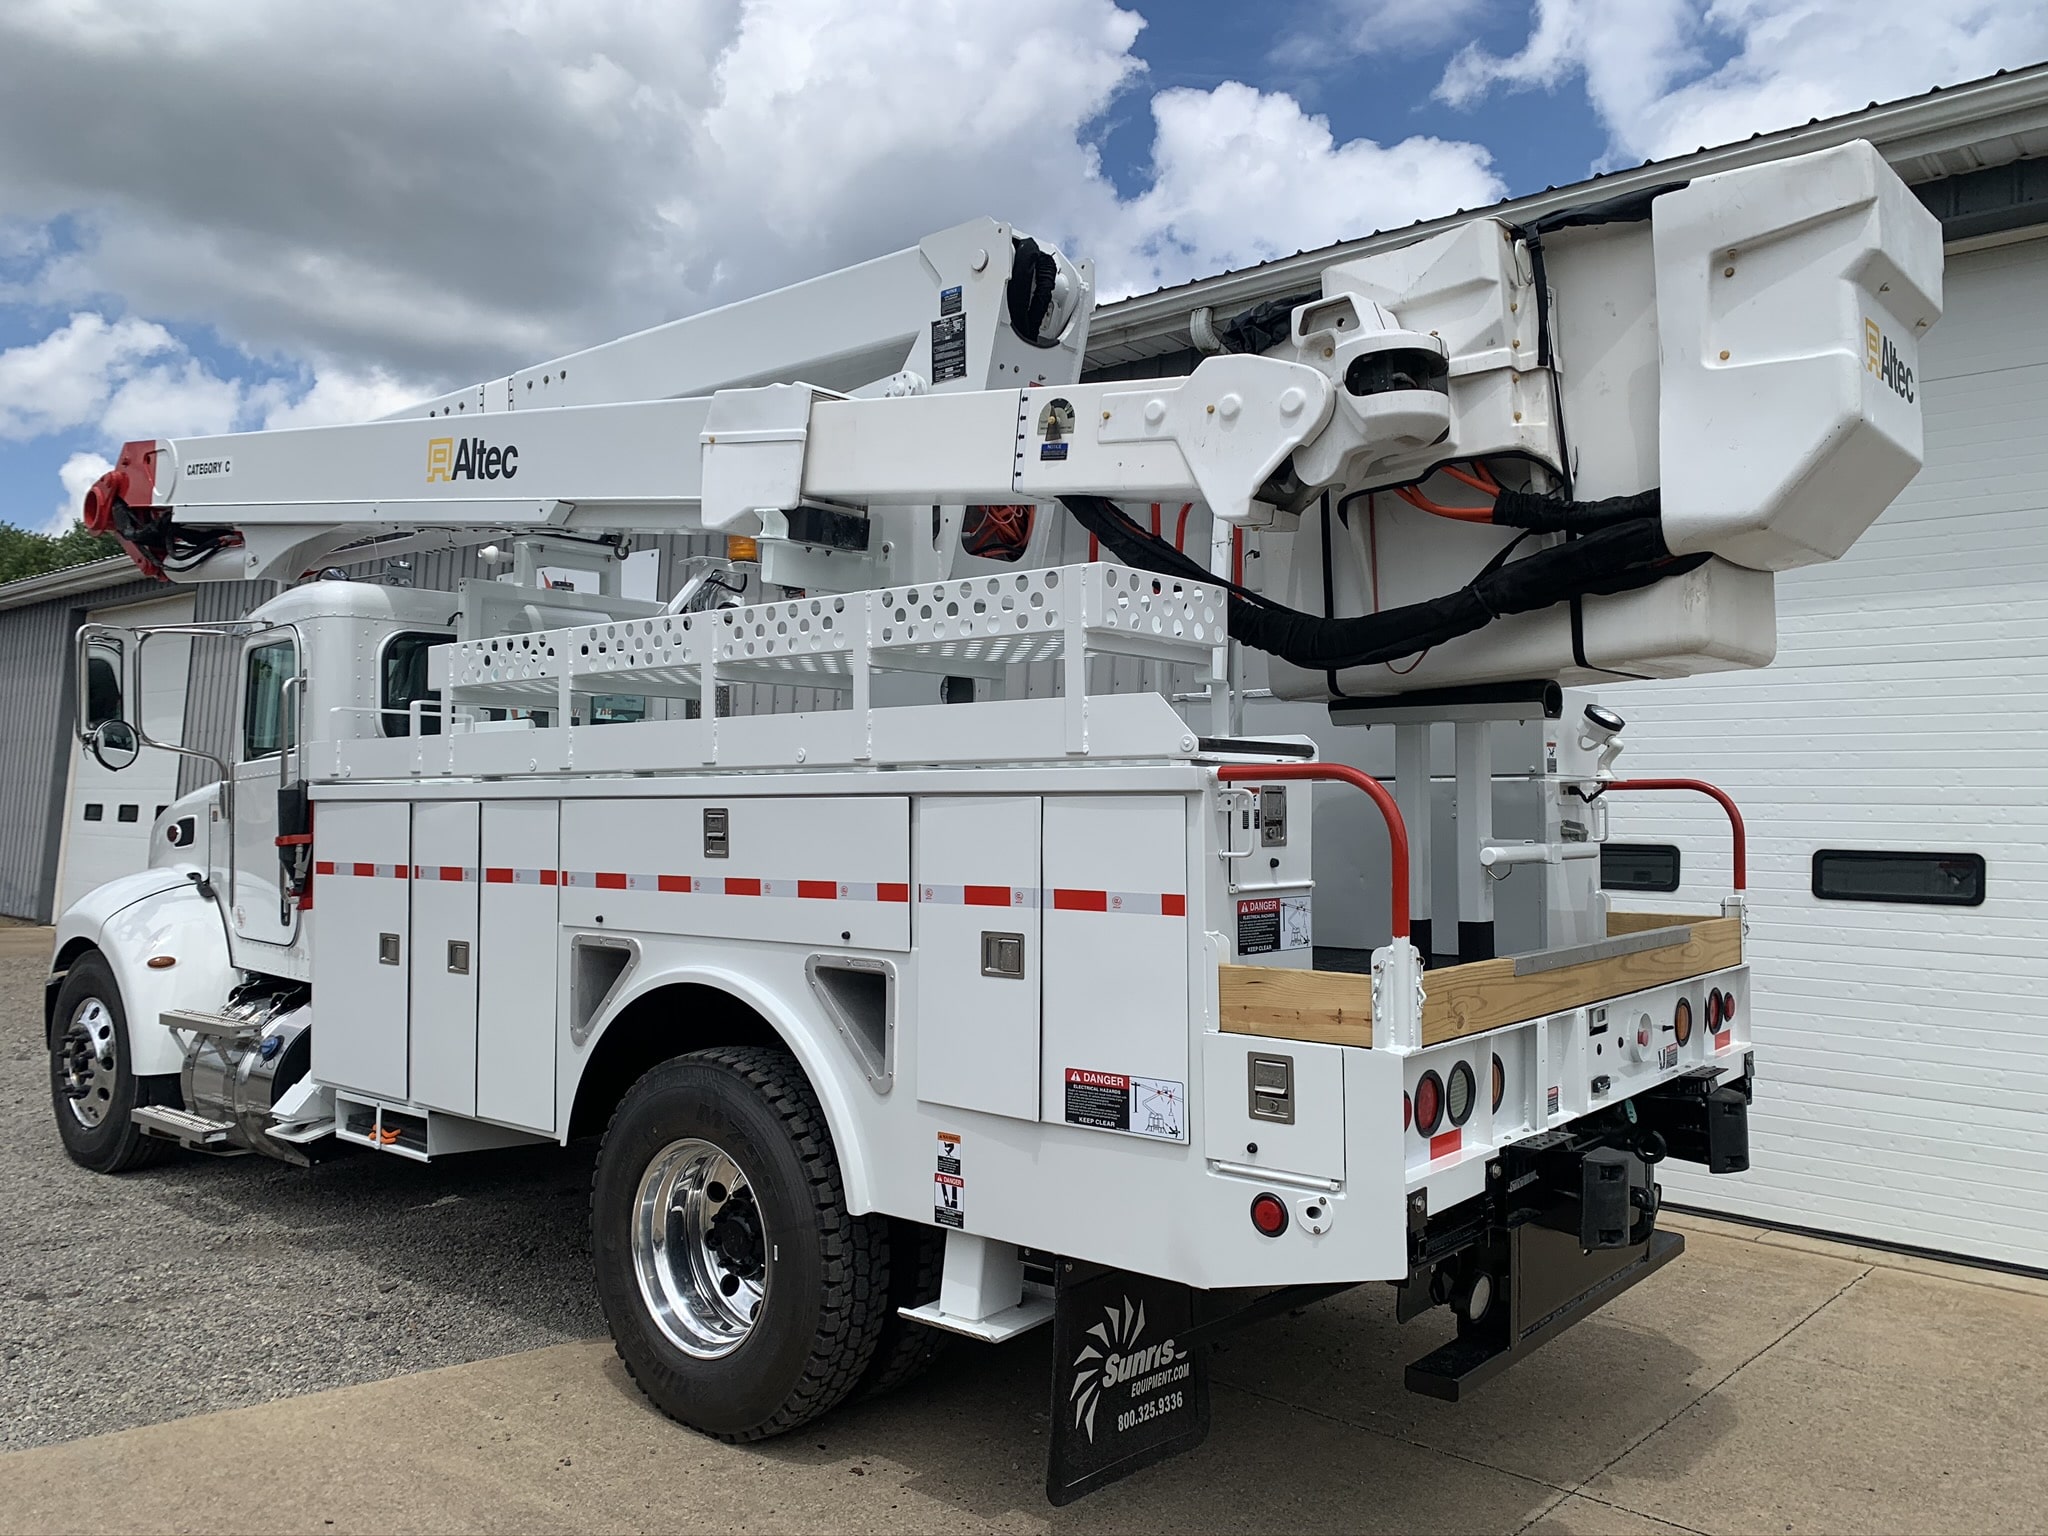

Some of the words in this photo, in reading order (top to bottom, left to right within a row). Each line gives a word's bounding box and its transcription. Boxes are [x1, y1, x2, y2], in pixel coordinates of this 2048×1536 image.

[1881, 335, 1914, 404] Altec
[451, 437, 519, 481] Altec
[187, 461, 222, 476] CATEGORY
[224, 460, 231, 473] C
[1250, 901, 1277, 911] DANGER
[1083, 1073, 1124, 1086] DANGER
[1073, 1084, 1098, 1092] ELECTRICAL
[1095, 1119, 1115, 1127] CLEAR
[943, 1176, 962, 1187] DANGER
[1103, 1339, 1188, 1388] Sunris
[1131, 1363, 1190, 1397] EQUIPMENT.COM
[1118, 1391, 1183, 1432] 800.325.9336
